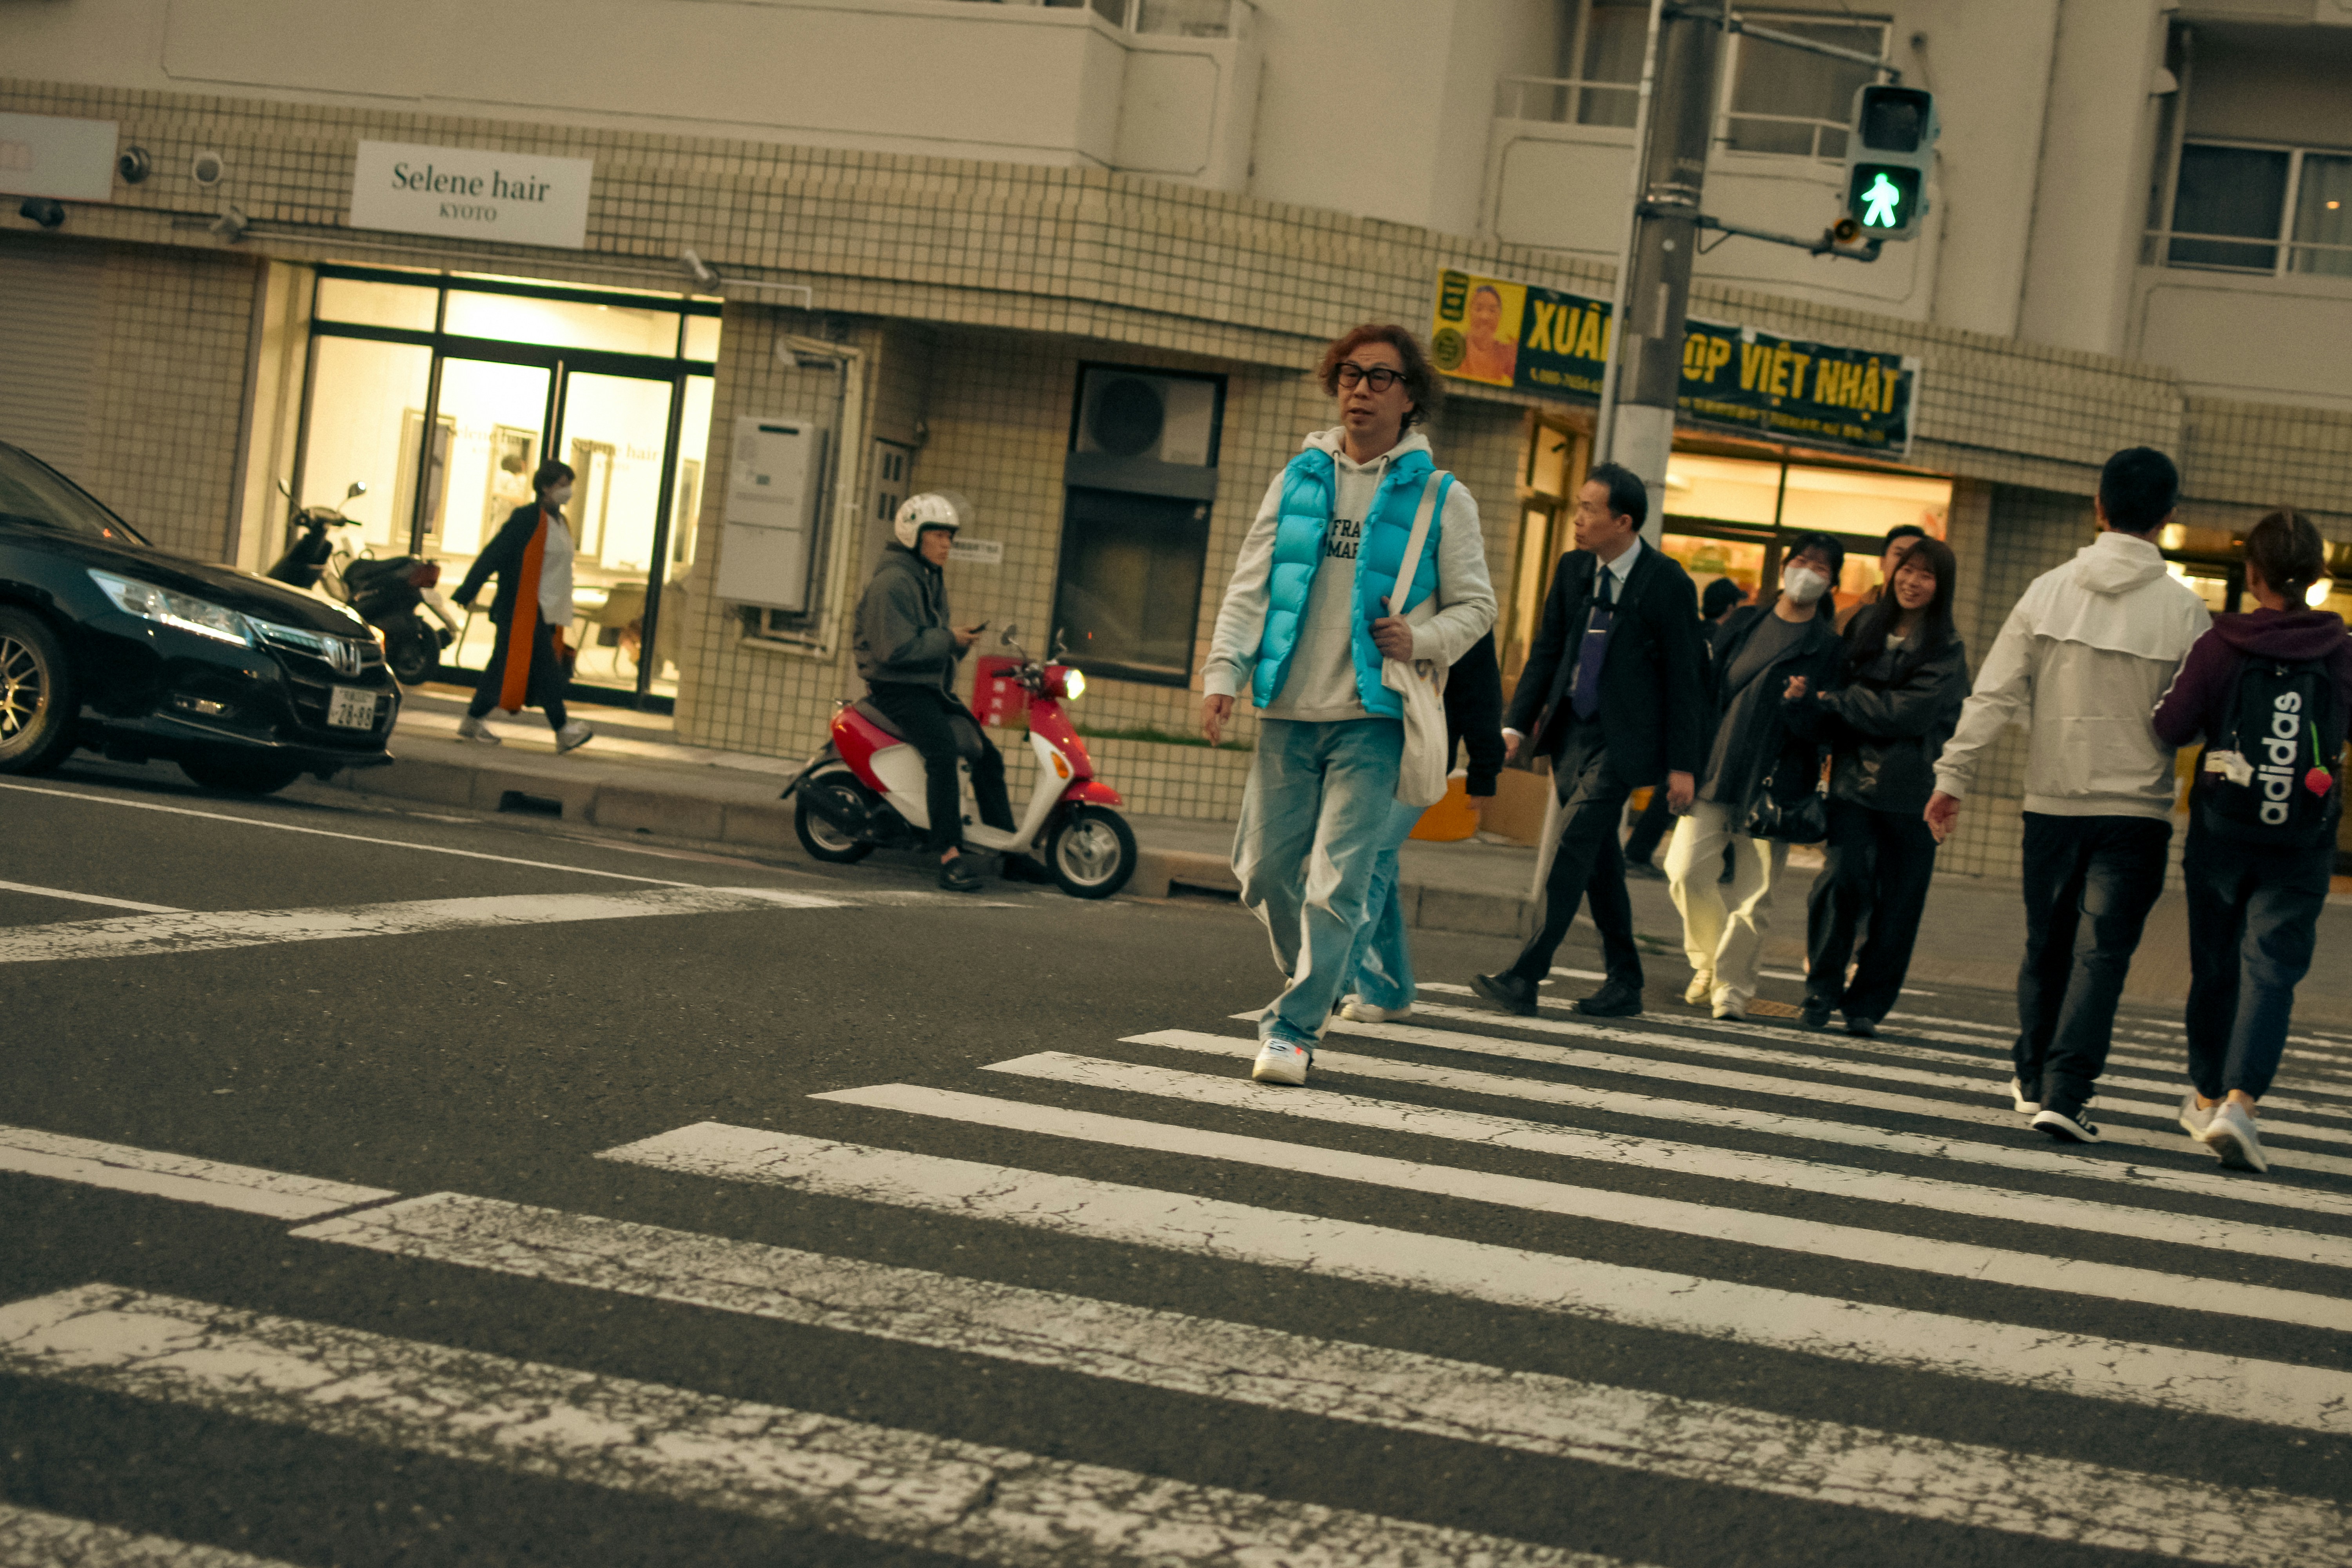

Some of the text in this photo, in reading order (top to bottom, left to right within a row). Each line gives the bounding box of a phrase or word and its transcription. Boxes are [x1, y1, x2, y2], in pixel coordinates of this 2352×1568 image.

[392, 162, 550, 201] Selene hair
[439, 203, 497, 222] KYOTO
[1683, 333, 1731, 383] OP
[1740, 342, 1810, 406] VIỆT
[1815, 358, 1898, 421] NHẬT
[1332, 520, 1360, 537] FRA
[2258, 691, 2302, 824] adidas
